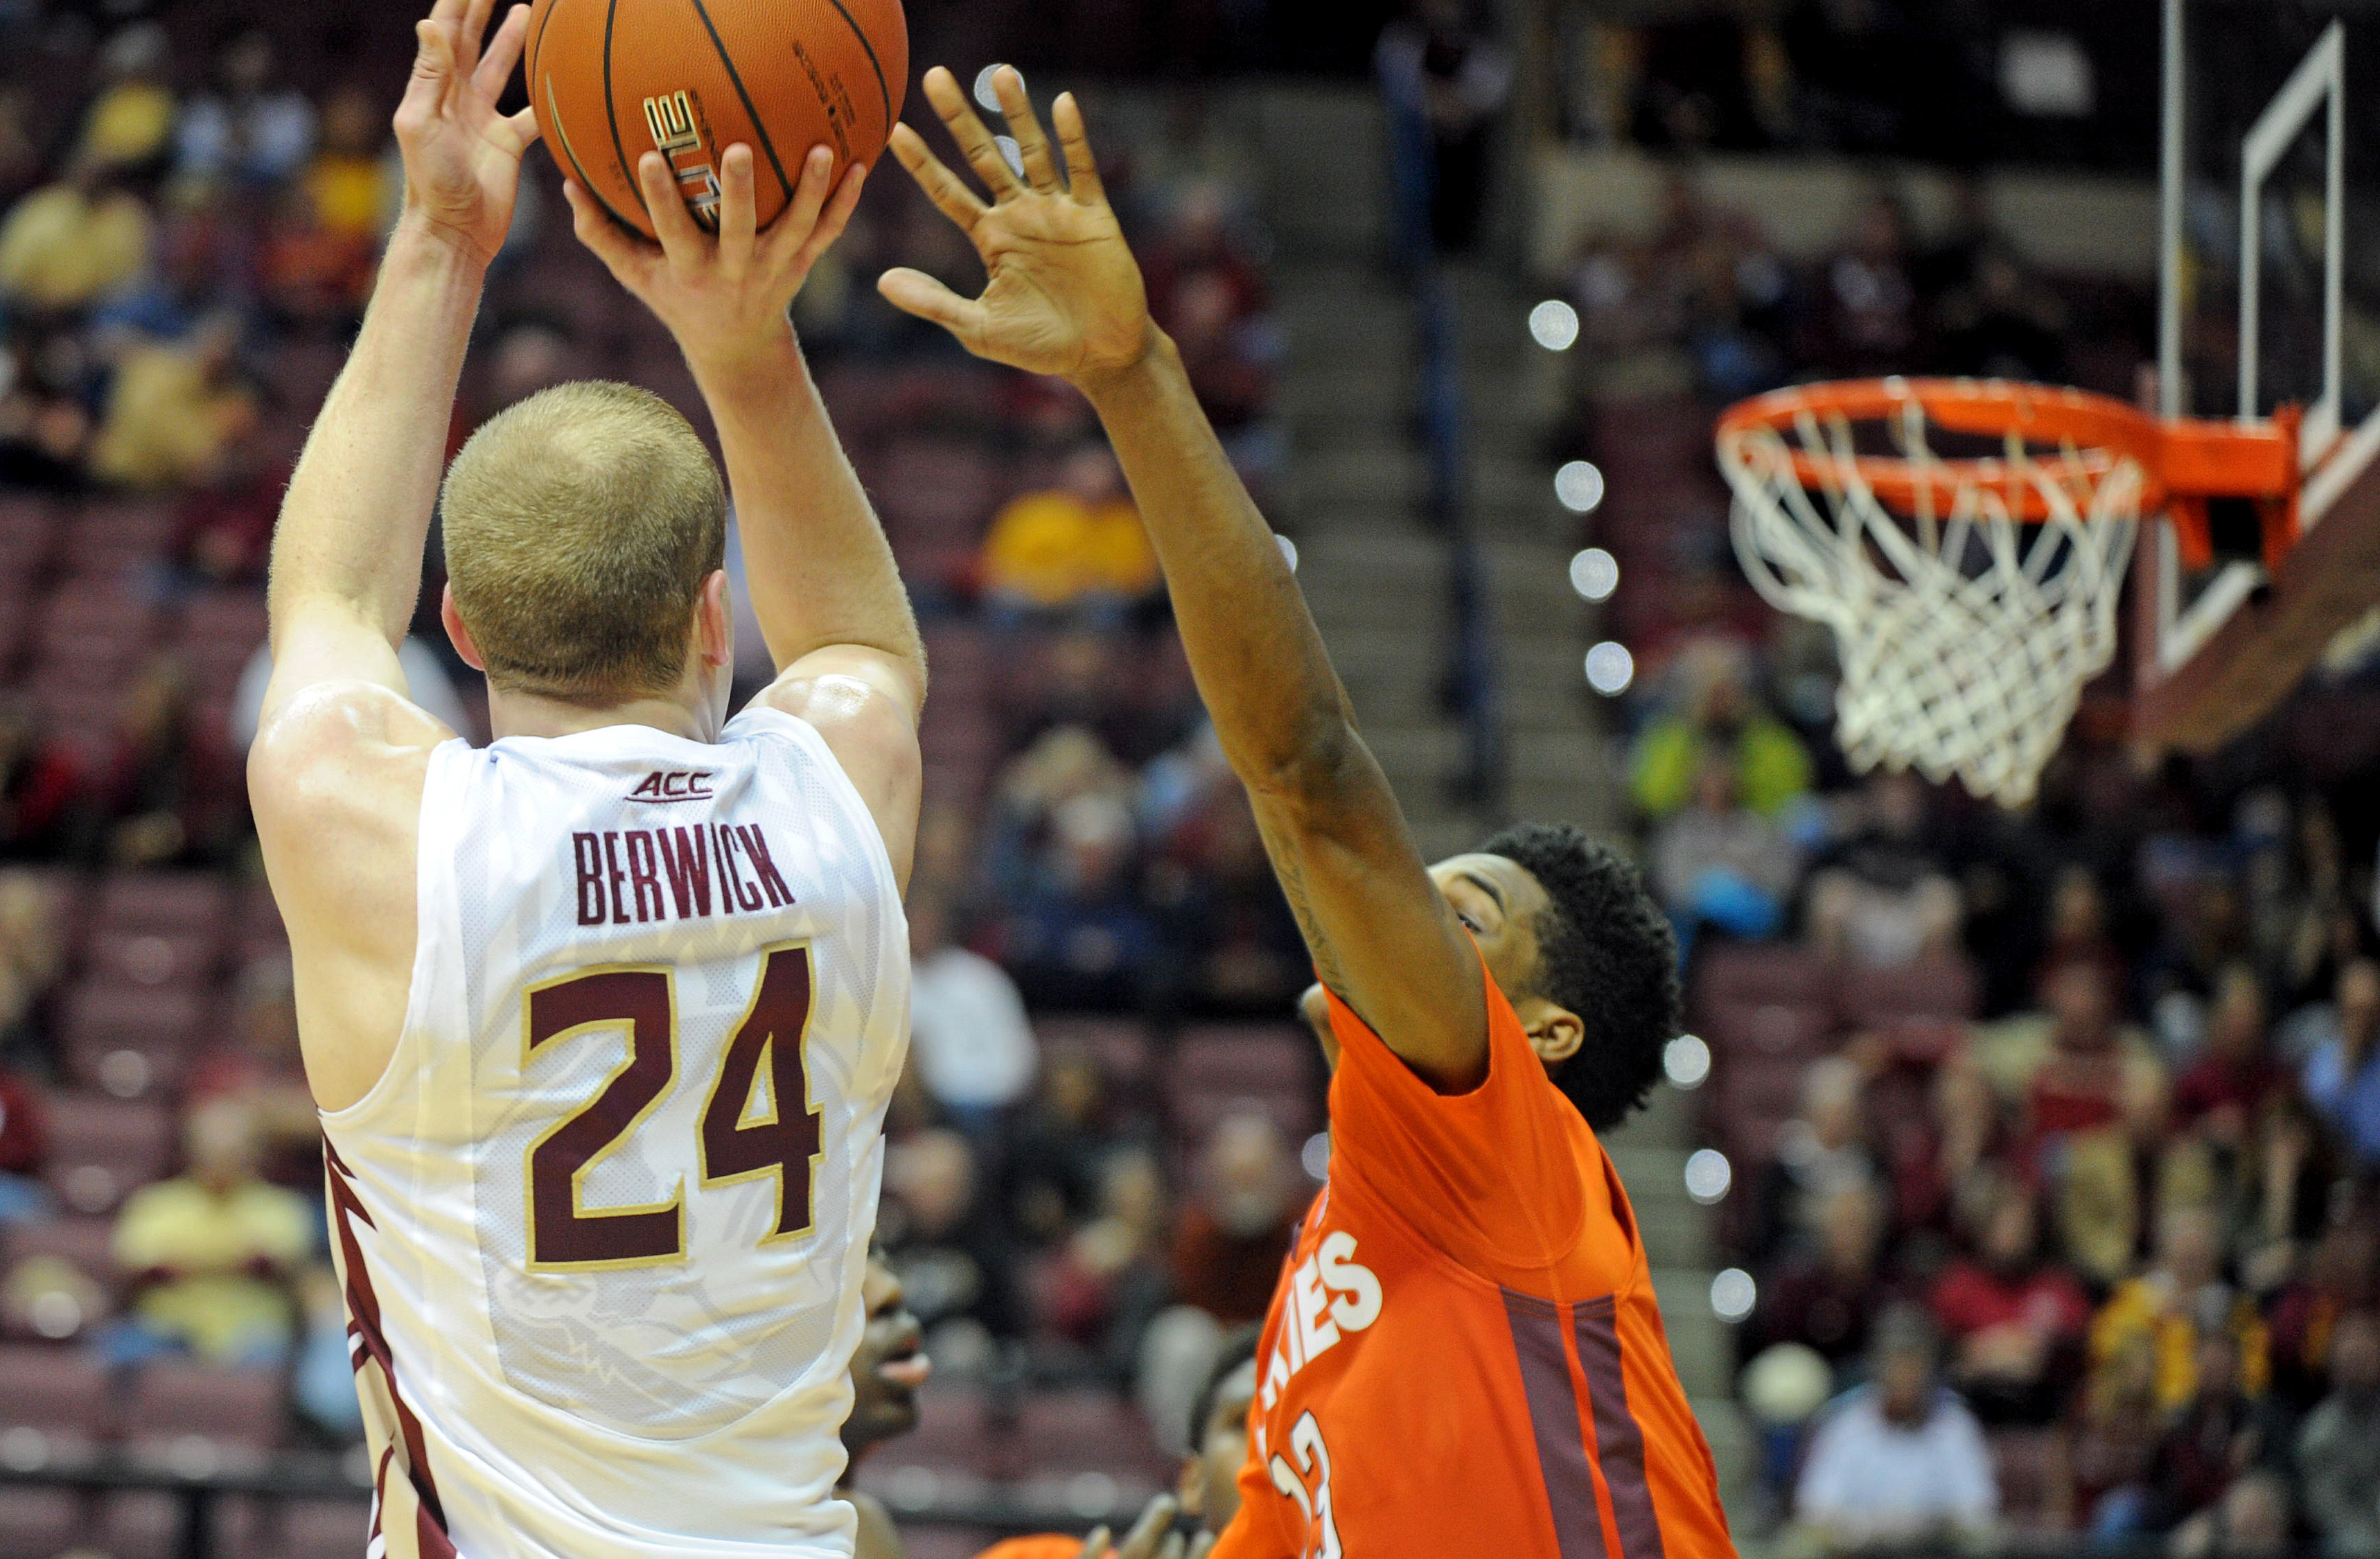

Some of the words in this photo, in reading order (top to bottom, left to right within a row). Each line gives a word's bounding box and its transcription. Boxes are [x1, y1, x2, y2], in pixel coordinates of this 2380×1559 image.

[631, 772, 713, 795] ACC
[573, 822, 795, 926] BERWICK
[520, 937, 826, 1273] 24
